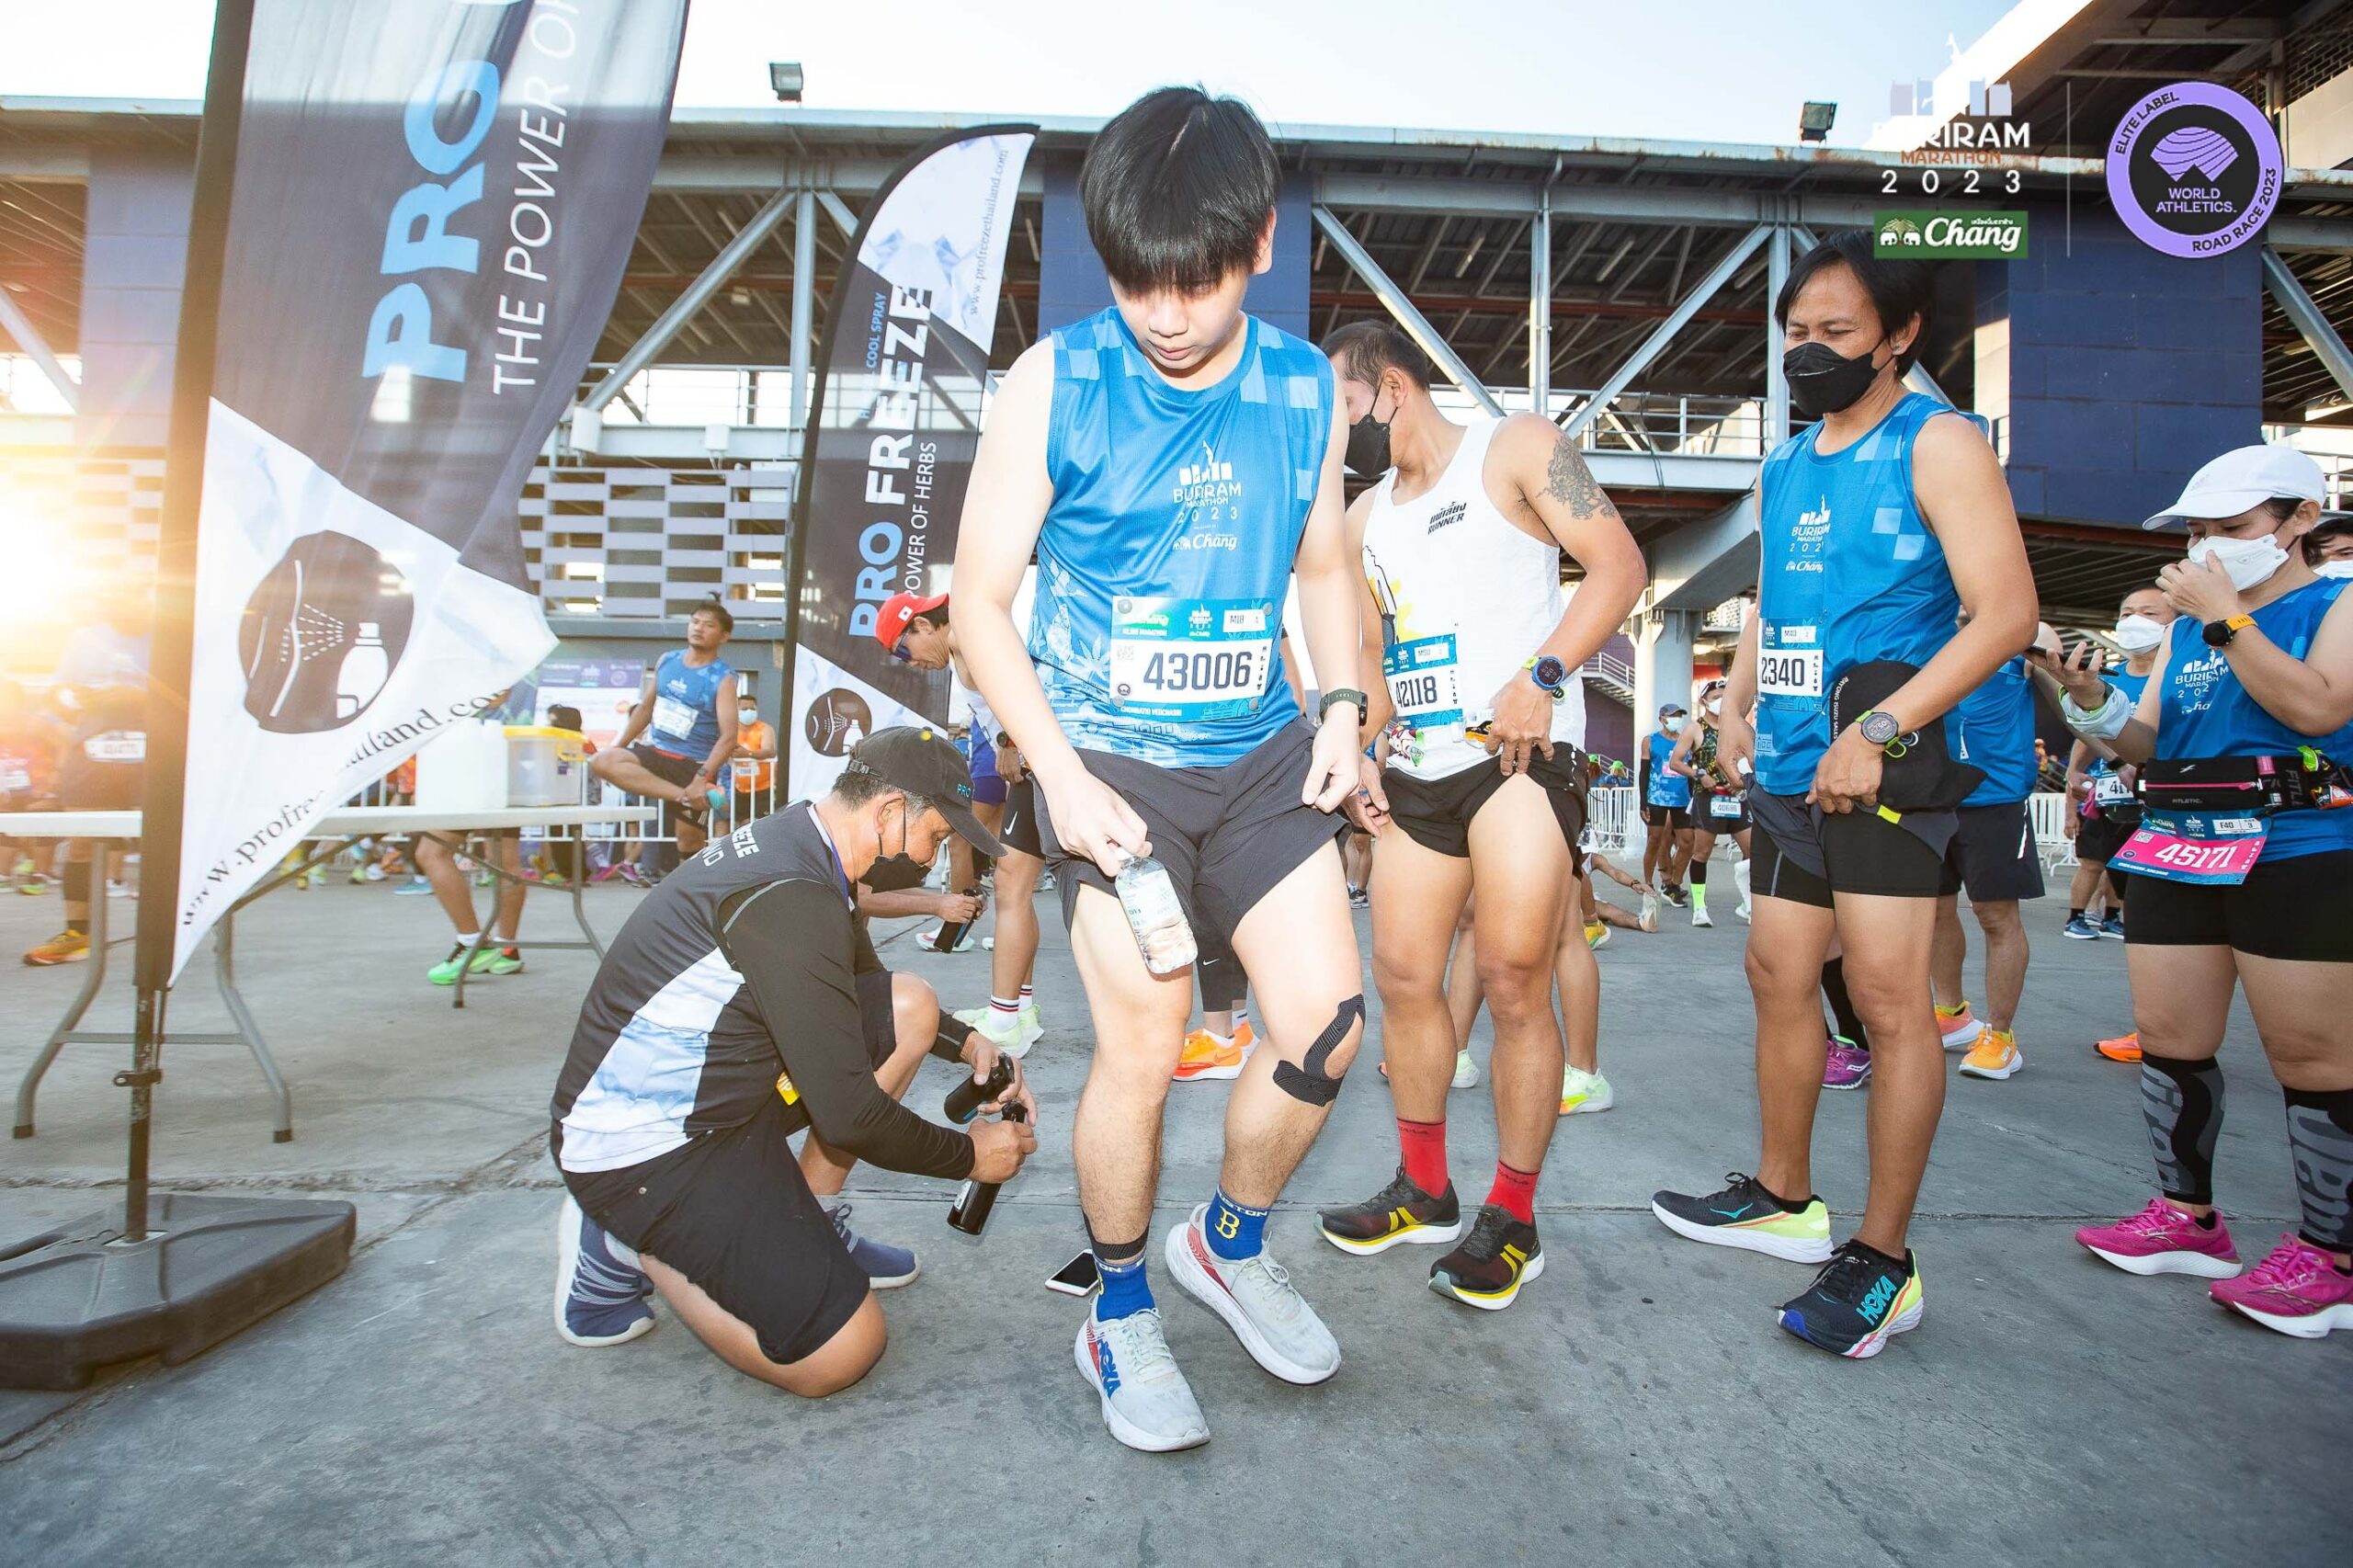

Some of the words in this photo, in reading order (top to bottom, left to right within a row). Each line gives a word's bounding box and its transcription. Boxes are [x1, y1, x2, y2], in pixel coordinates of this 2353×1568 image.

[504, 76, 569, 281] POWER
[361, 60, 501, 382] PRO
[871, 292, 887, 333] SPRAY
[493, 294, 545, 394] THE
[866, 335, 881, 369] COOL
[865, 284, 932, 506] FREEZE
[914, 441, 938, 499] HERBS
[1173, 483, 1242, 504] BURRAM
[910, 504, 928, 529] OF
[1193, 533, 1238, 551] Chang
[849, 521, 904, 638] PRO
[1143, 652, 1253, 690] 43006
[957, 783, 972, 798] PRO
[2154, 843, 2238, 869] 45171
[1214, 1205, 1240, 1239] B
[1855, 1275, 1897, 1325] HOKA
